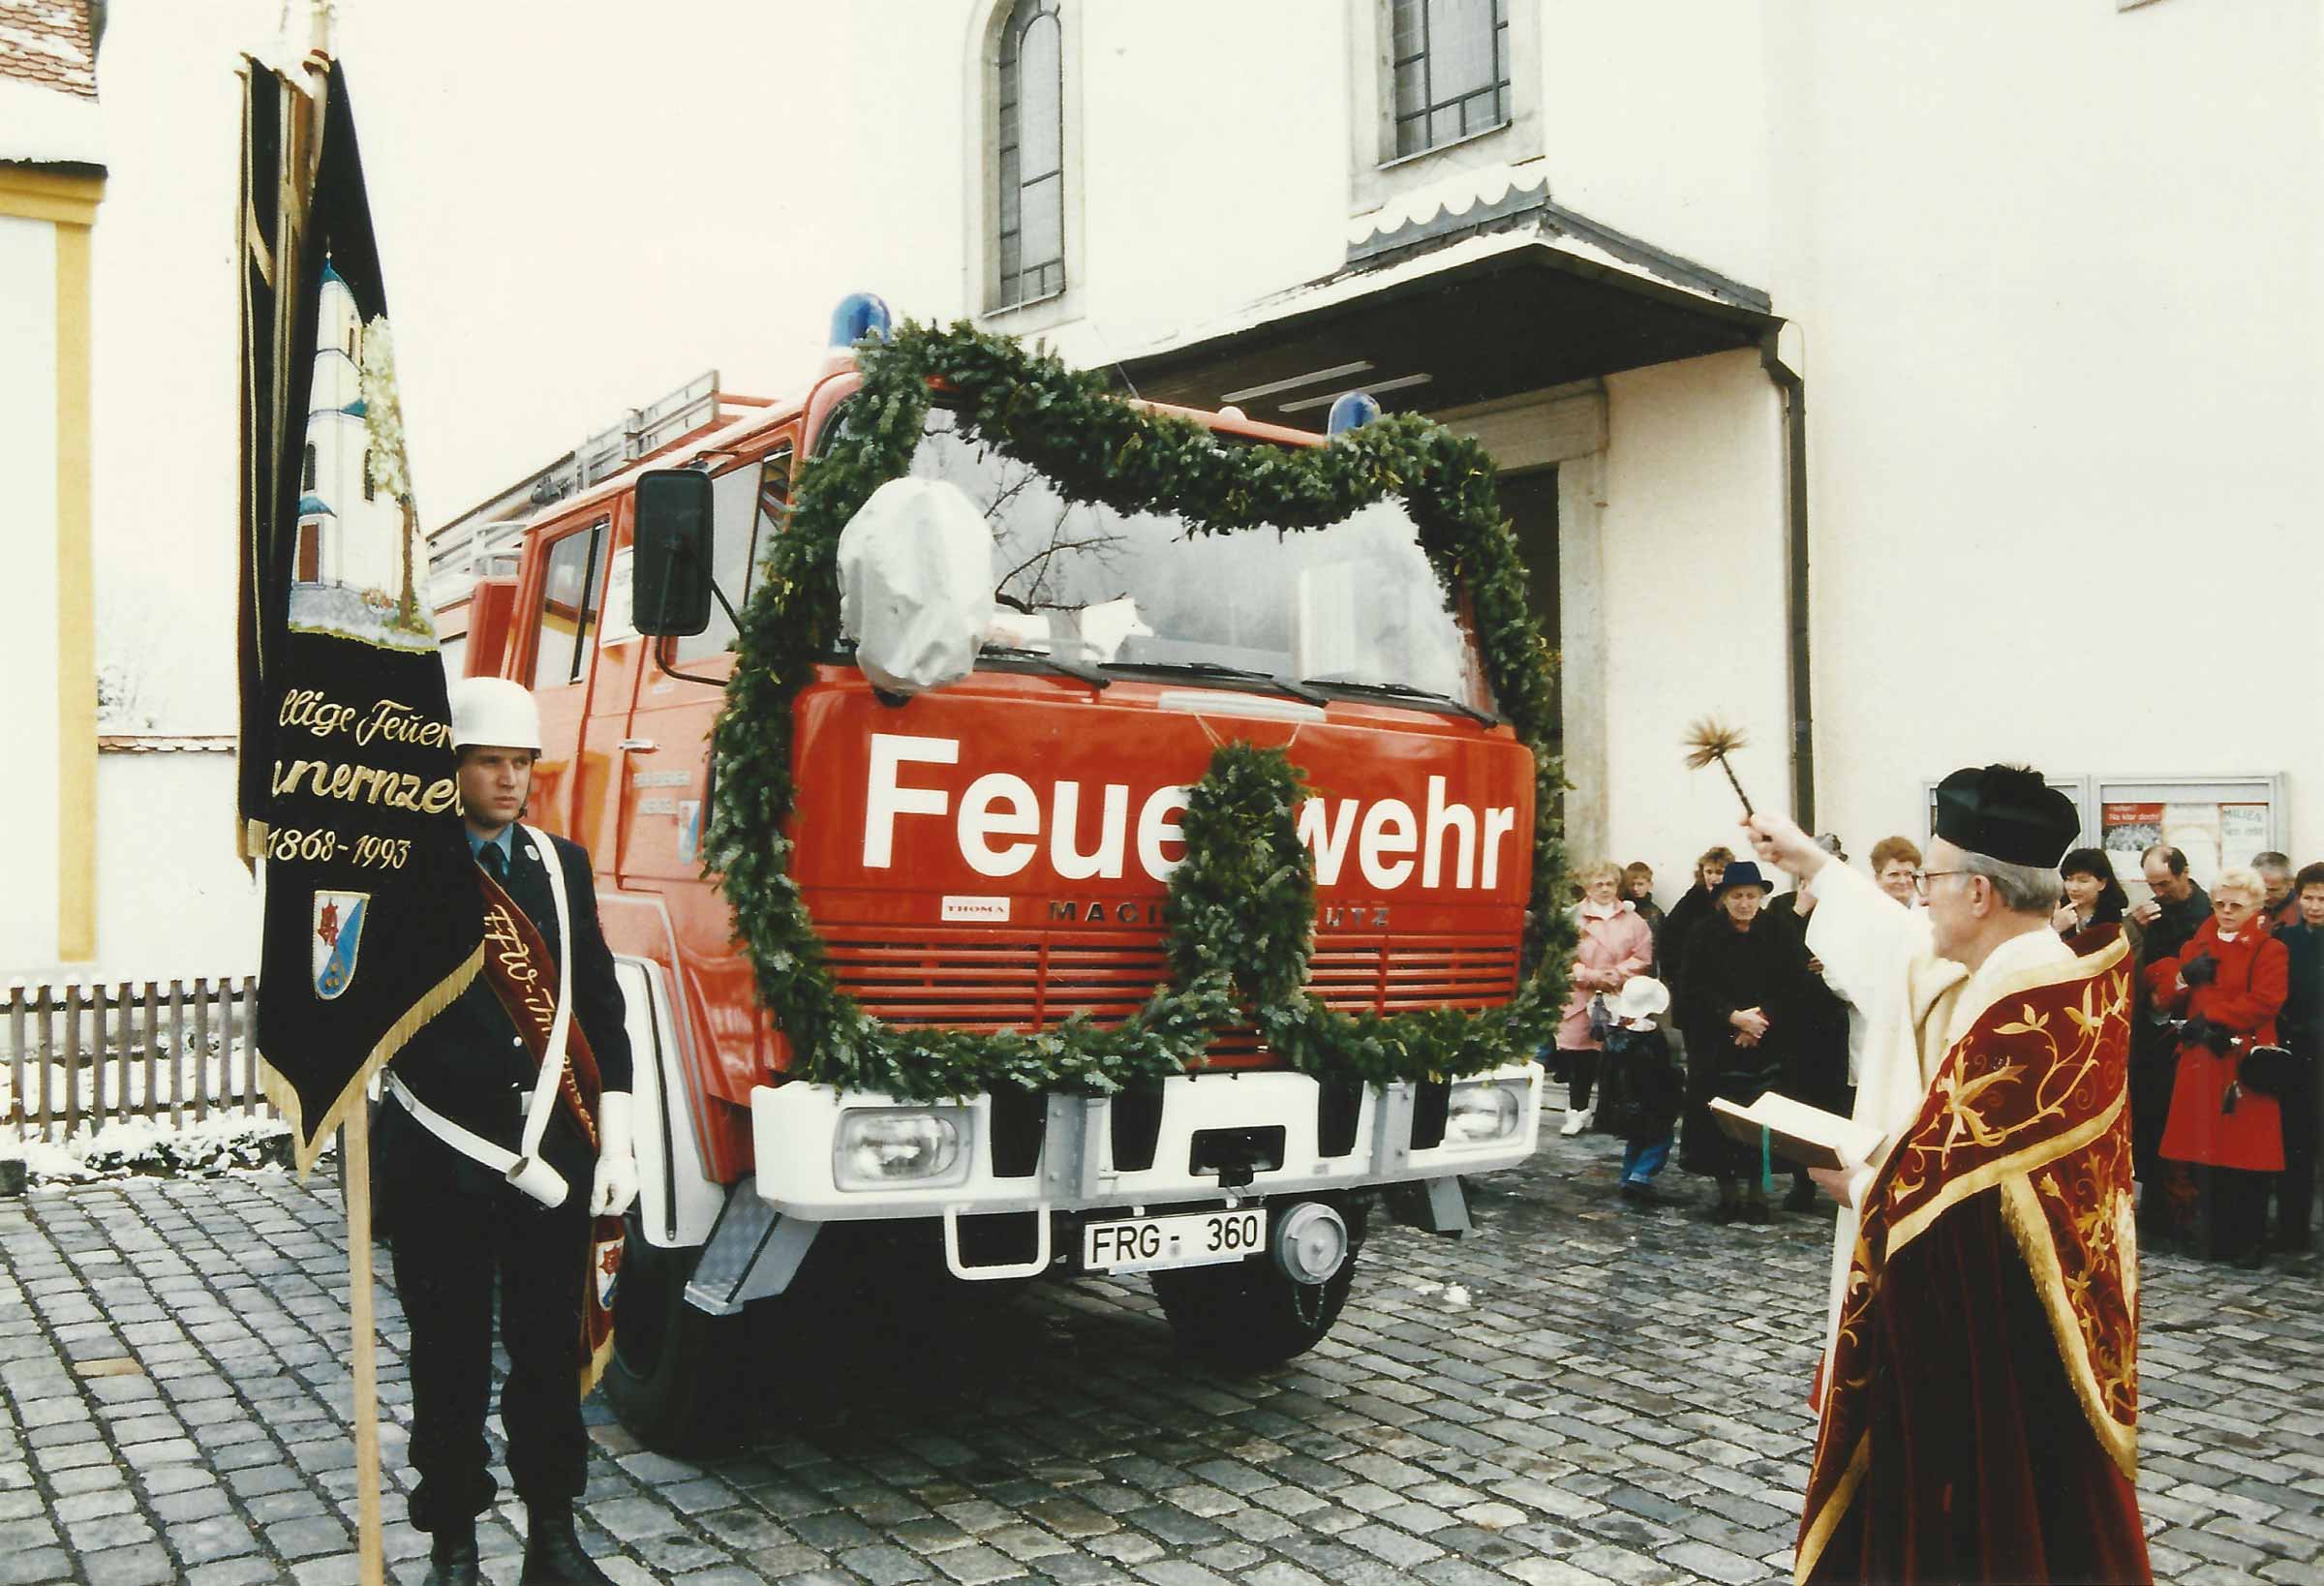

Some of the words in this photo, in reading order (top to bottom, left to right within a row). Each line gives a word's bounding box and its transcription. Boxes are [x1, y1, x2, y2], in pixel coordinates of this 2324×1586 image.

[862, 733, 1514, 890] Feuewehr
[267, 828, 412, 869] 1868-1993
[947, 904, 1005, 914] THOMA
[1050, 900, 1157, 925] MAGI
[1325, 906, 1390, 927] UTZ
[1207, 1214, 1258, 1252] 360
